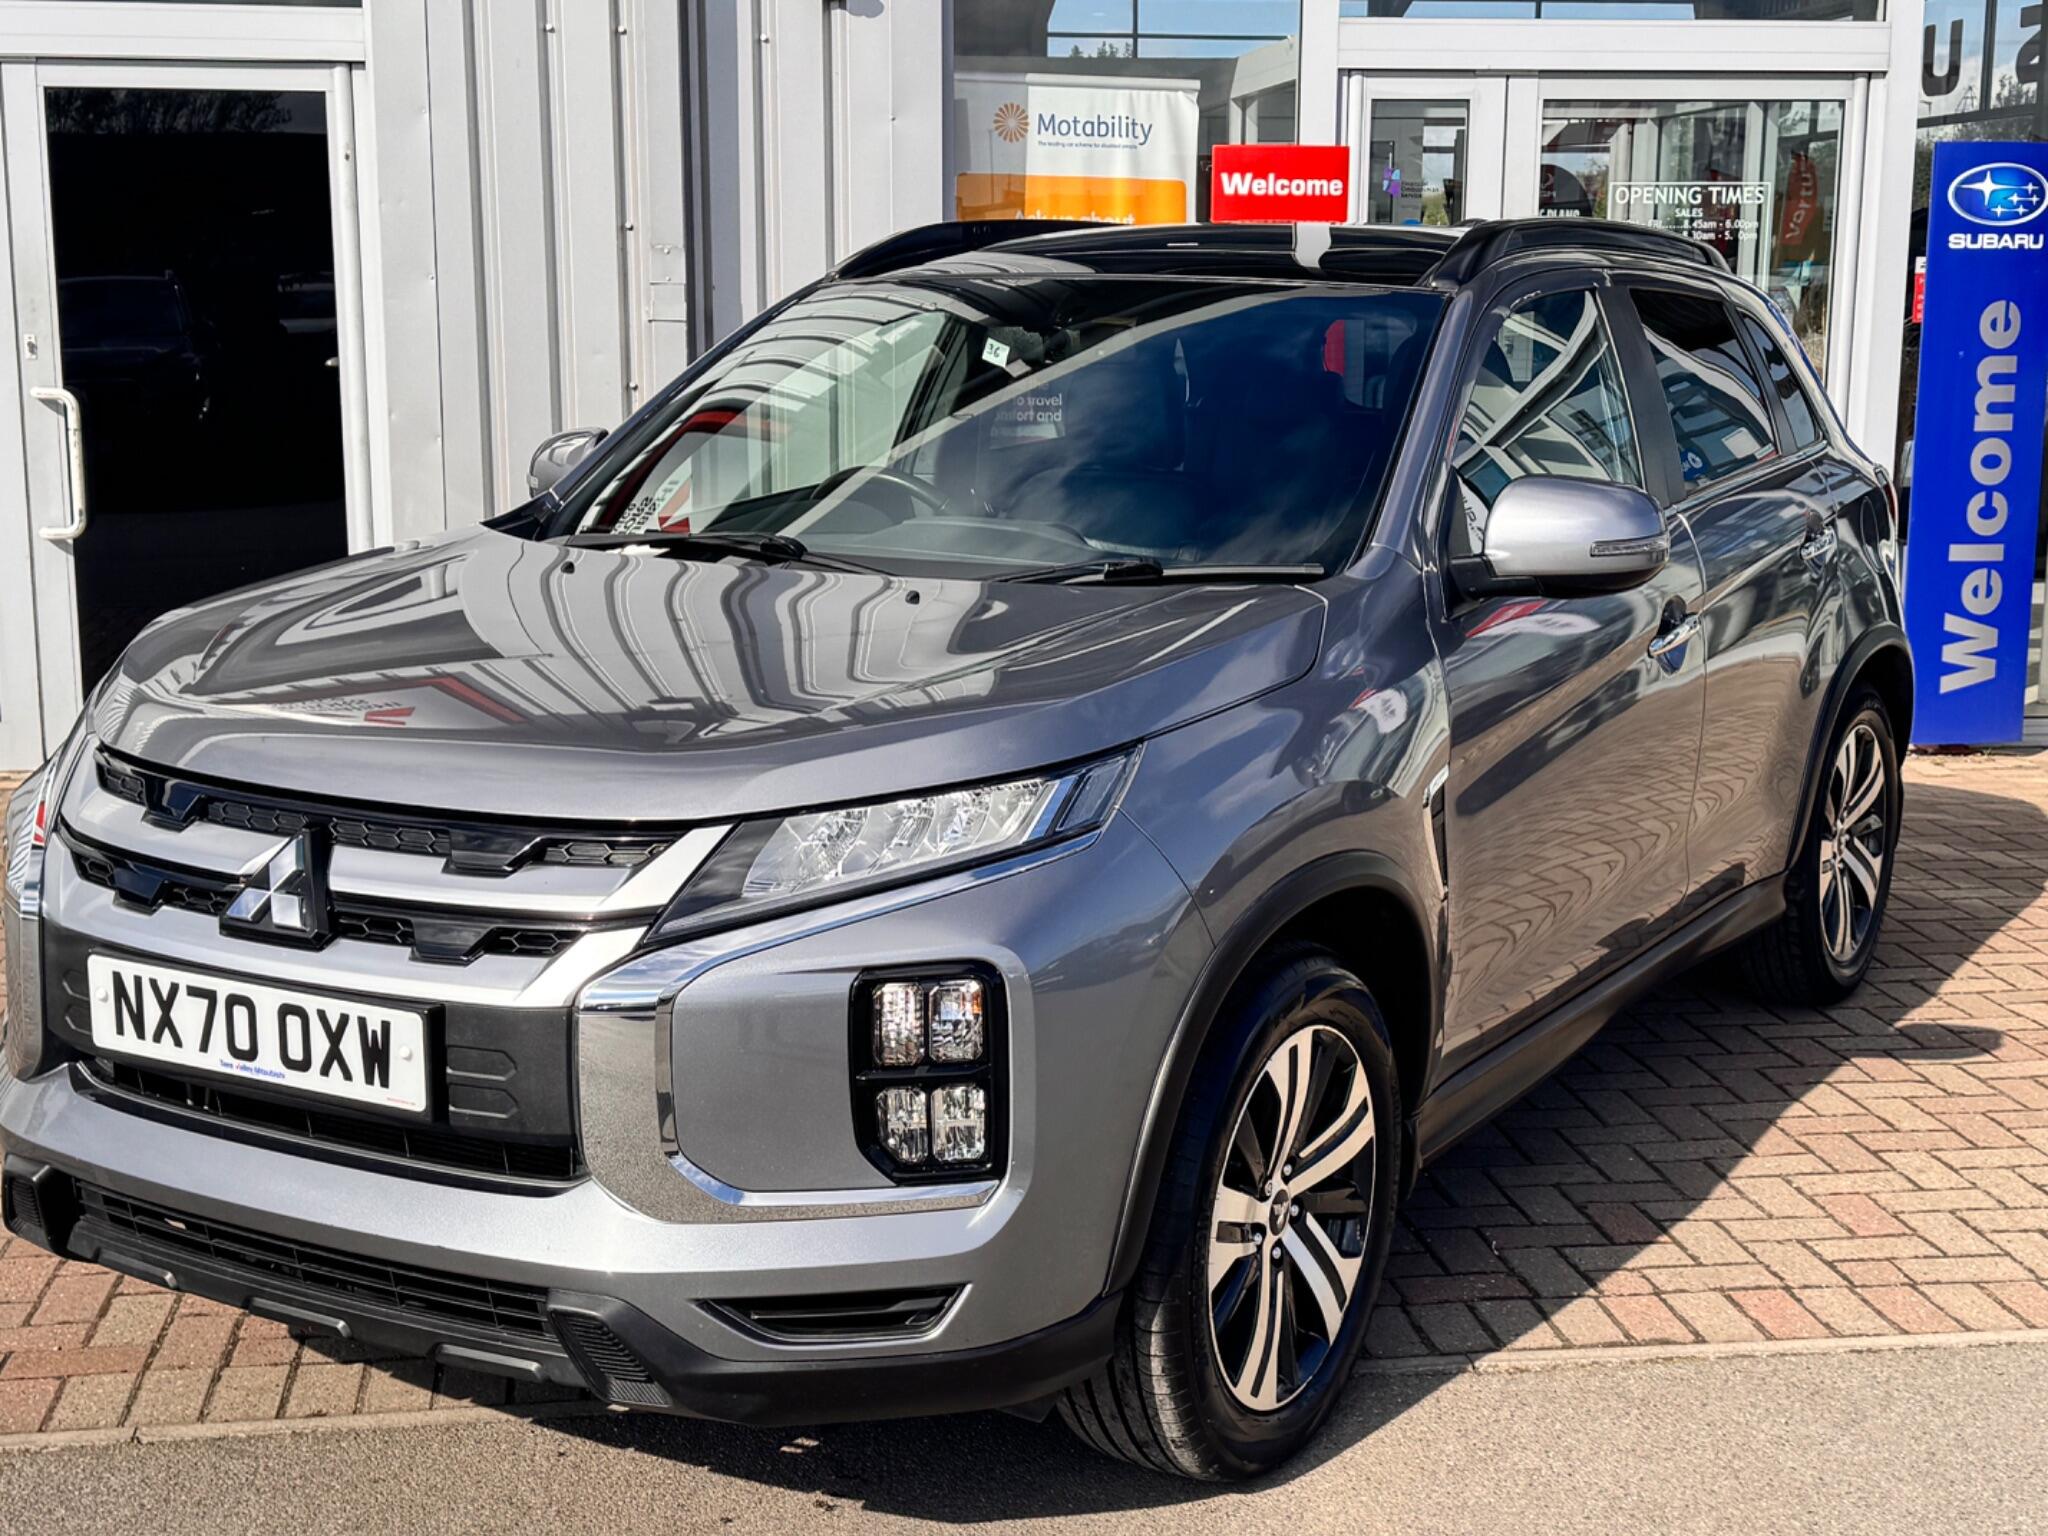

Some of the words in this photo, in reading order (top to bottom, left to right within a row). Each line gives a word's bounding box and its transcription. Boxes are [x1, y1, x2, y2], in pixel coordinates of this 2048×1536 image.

[1037, 112, 1153, 146] Motability
[1220, 172, 1344, 196] Welcome
[1614, 186, 1702, 204] OPENING
[1708, 186, 1765, 204] TIMES
[1674, 207, 1703, 218] SALES
[1725, 219, 1759, 231] 6.00pm
[1724, 230, 1757, 241] 5.0pm
[1948, 233, 2045, 250] SUBARU
[1027, 393, 1062, 406] travel
[1036, 408, 1062, 421] and
[1939, 299, 2021, 694] Welcome
[112, 970, 259, 1062] NX70
[277, 1003, 391, 1089] OXW
